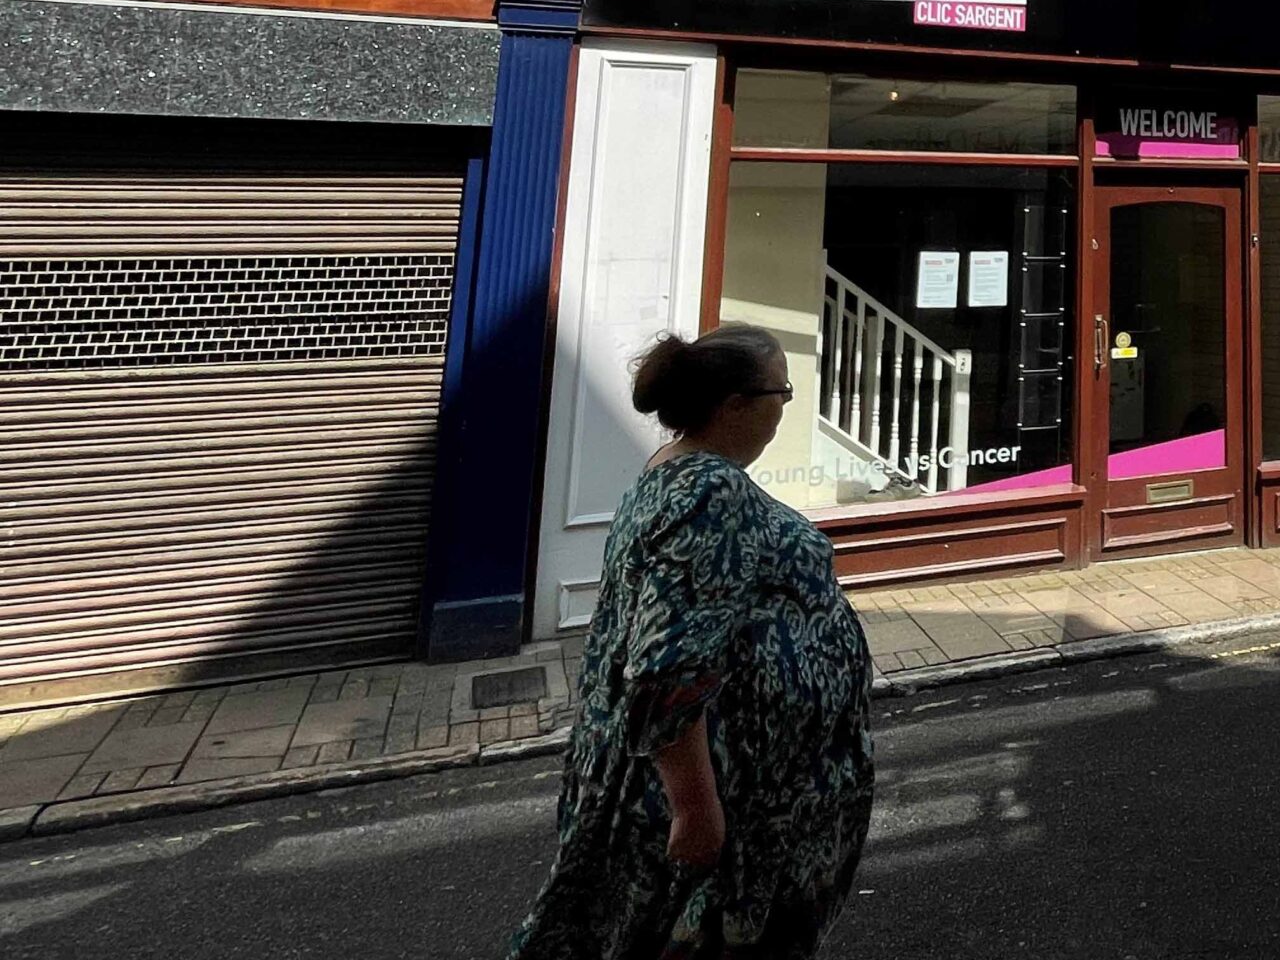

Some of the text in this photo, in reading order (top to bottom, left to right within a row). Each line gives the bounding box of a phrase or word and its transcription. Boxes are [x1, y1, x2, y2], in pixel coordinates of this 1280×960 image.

[917, 1, 1024, 29] CLIC SARGENT
[1119, 108, 1218, 139] WELCOME
